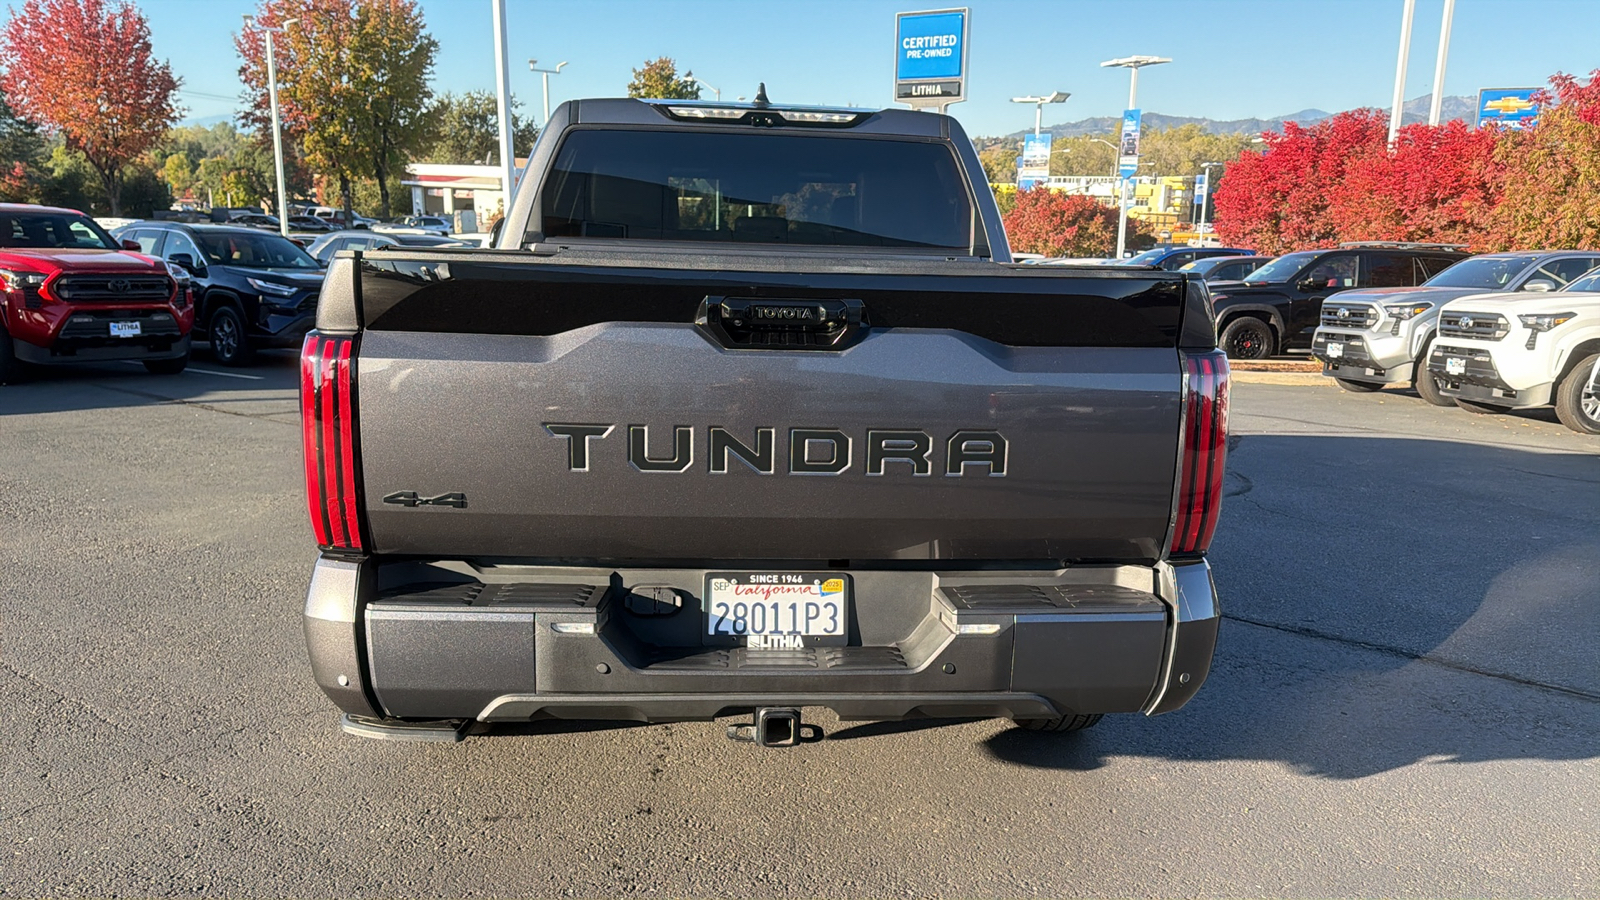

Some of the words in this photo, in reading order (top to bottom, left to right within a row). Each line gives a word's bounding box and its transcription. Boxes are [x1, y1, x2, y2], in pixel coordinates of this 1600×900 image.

[902, 34, 957, 49] CERTIFIED
[906, 48, 952, 59] PRE-OWNED
[911, 84, 942, 96] LITHIA
[755, 306, 813, 319] TOYOTA
[117, 323, 139, 331] LITHIA
[542, 422, 1009, 477] TUNDRA
[749, 575, 779, 584] SINCE
[781, 575, 803, 584] 1946
[713, 582, 730, 591] SEP
[734, 584, 820, 600] California
[714, 602, 838, 635] 28011P3
[760, 635, 804, 648] LITHIA
